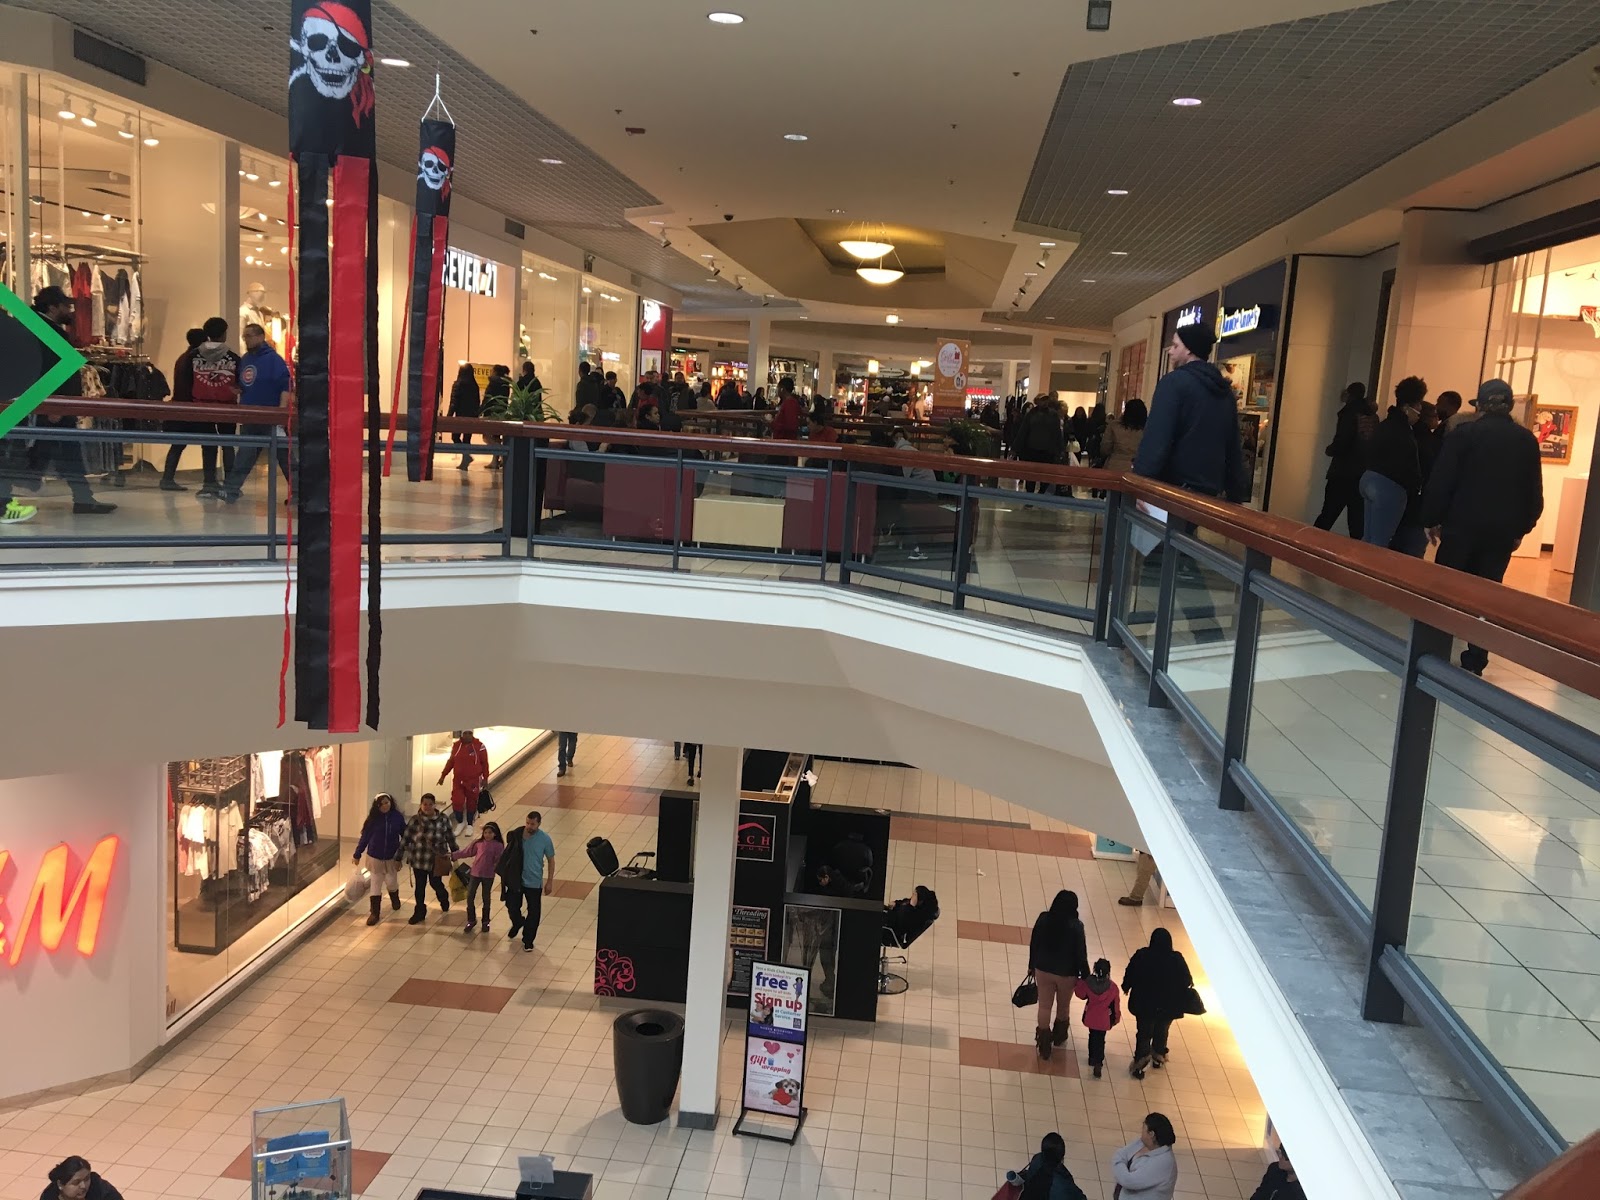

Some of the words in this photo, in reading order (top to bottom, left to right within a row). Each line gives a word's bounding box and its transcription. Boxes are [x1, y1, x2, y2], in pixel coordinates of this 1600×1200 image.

[441, 249, 481, 294] REVER
[484, 262, 498, 298] 21
[734, 908, 767, 920] Threading
[756, 972, 788, 990] free
[754, 992, 782, 1009] Sign
[786, 999, 803, 1013] up
[780, 1009, 801, 1017] Customer
[750, 1054, 767, 1066] Gift
[761, 1064, 791, 1075] wrapping
